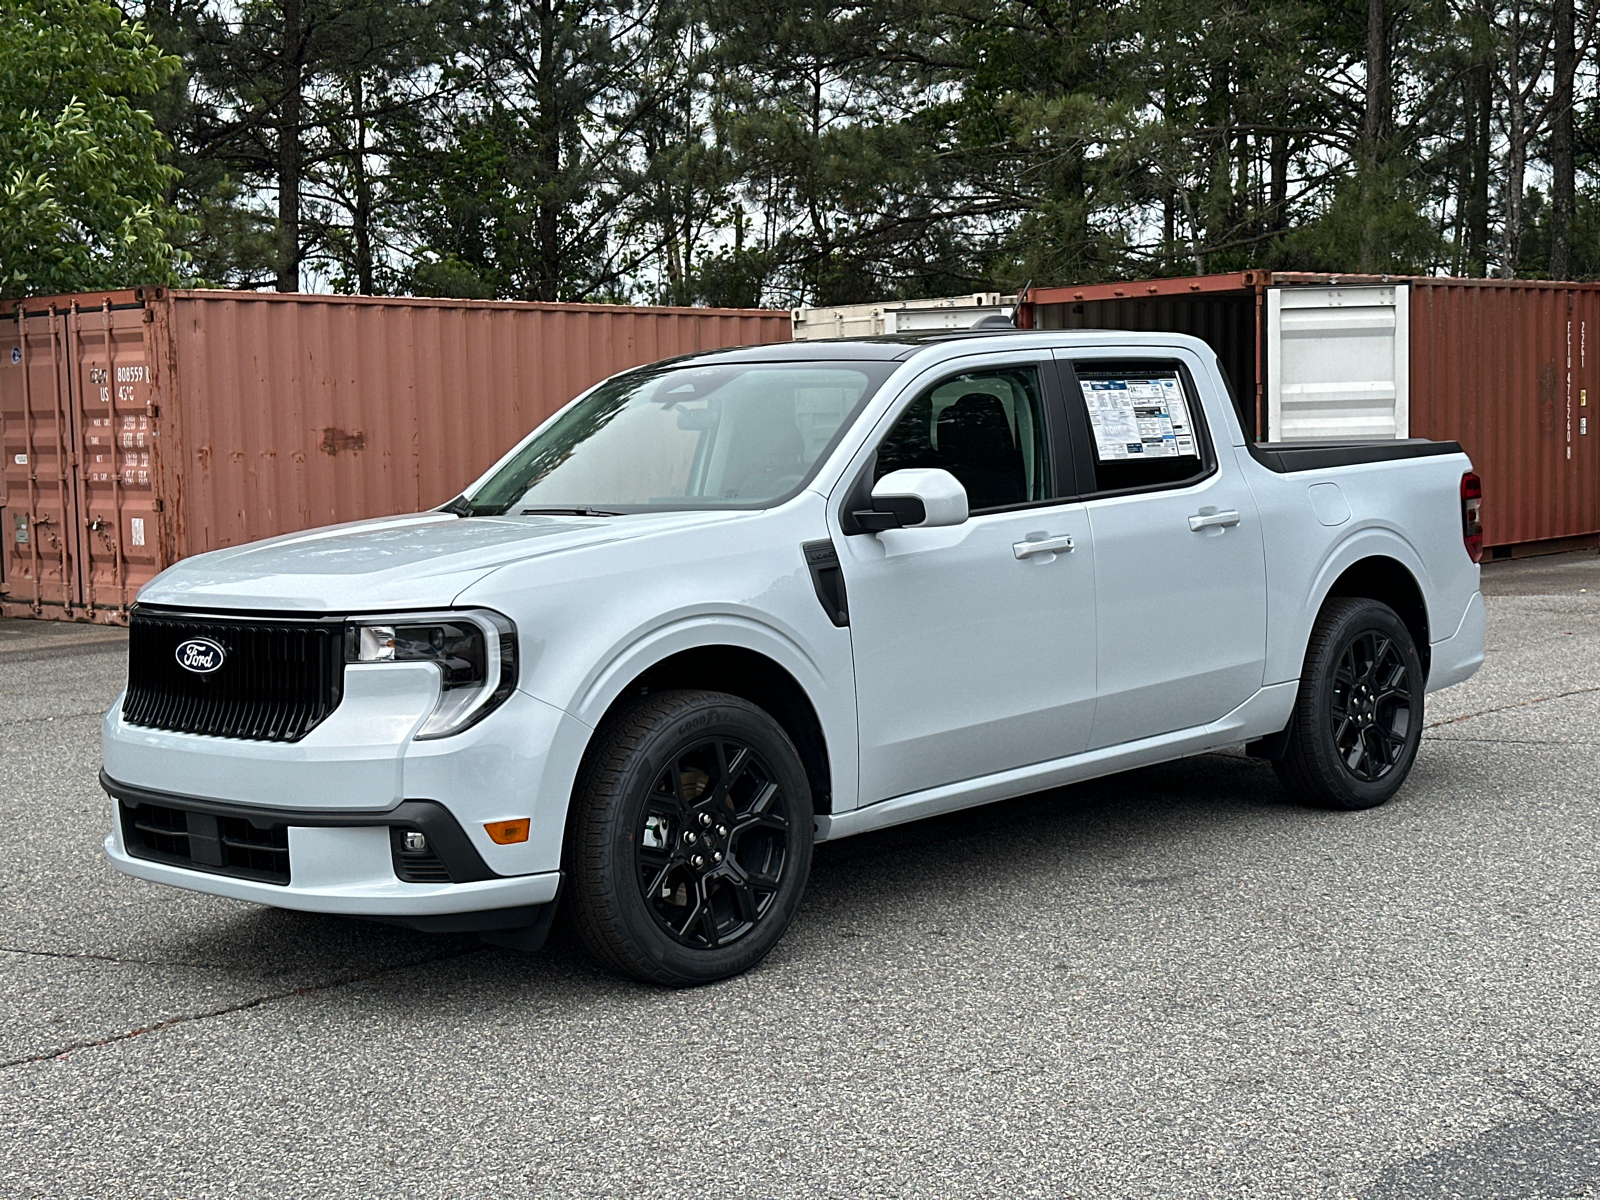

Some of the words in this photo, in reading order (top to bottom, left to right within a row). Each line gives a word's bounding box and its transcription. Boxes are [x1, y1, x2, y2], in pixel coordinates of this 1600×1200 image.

[117, 366, 143, 382] 808559
[100, 387, 109, 402] US
[184, 644, 213, 667] Ford
